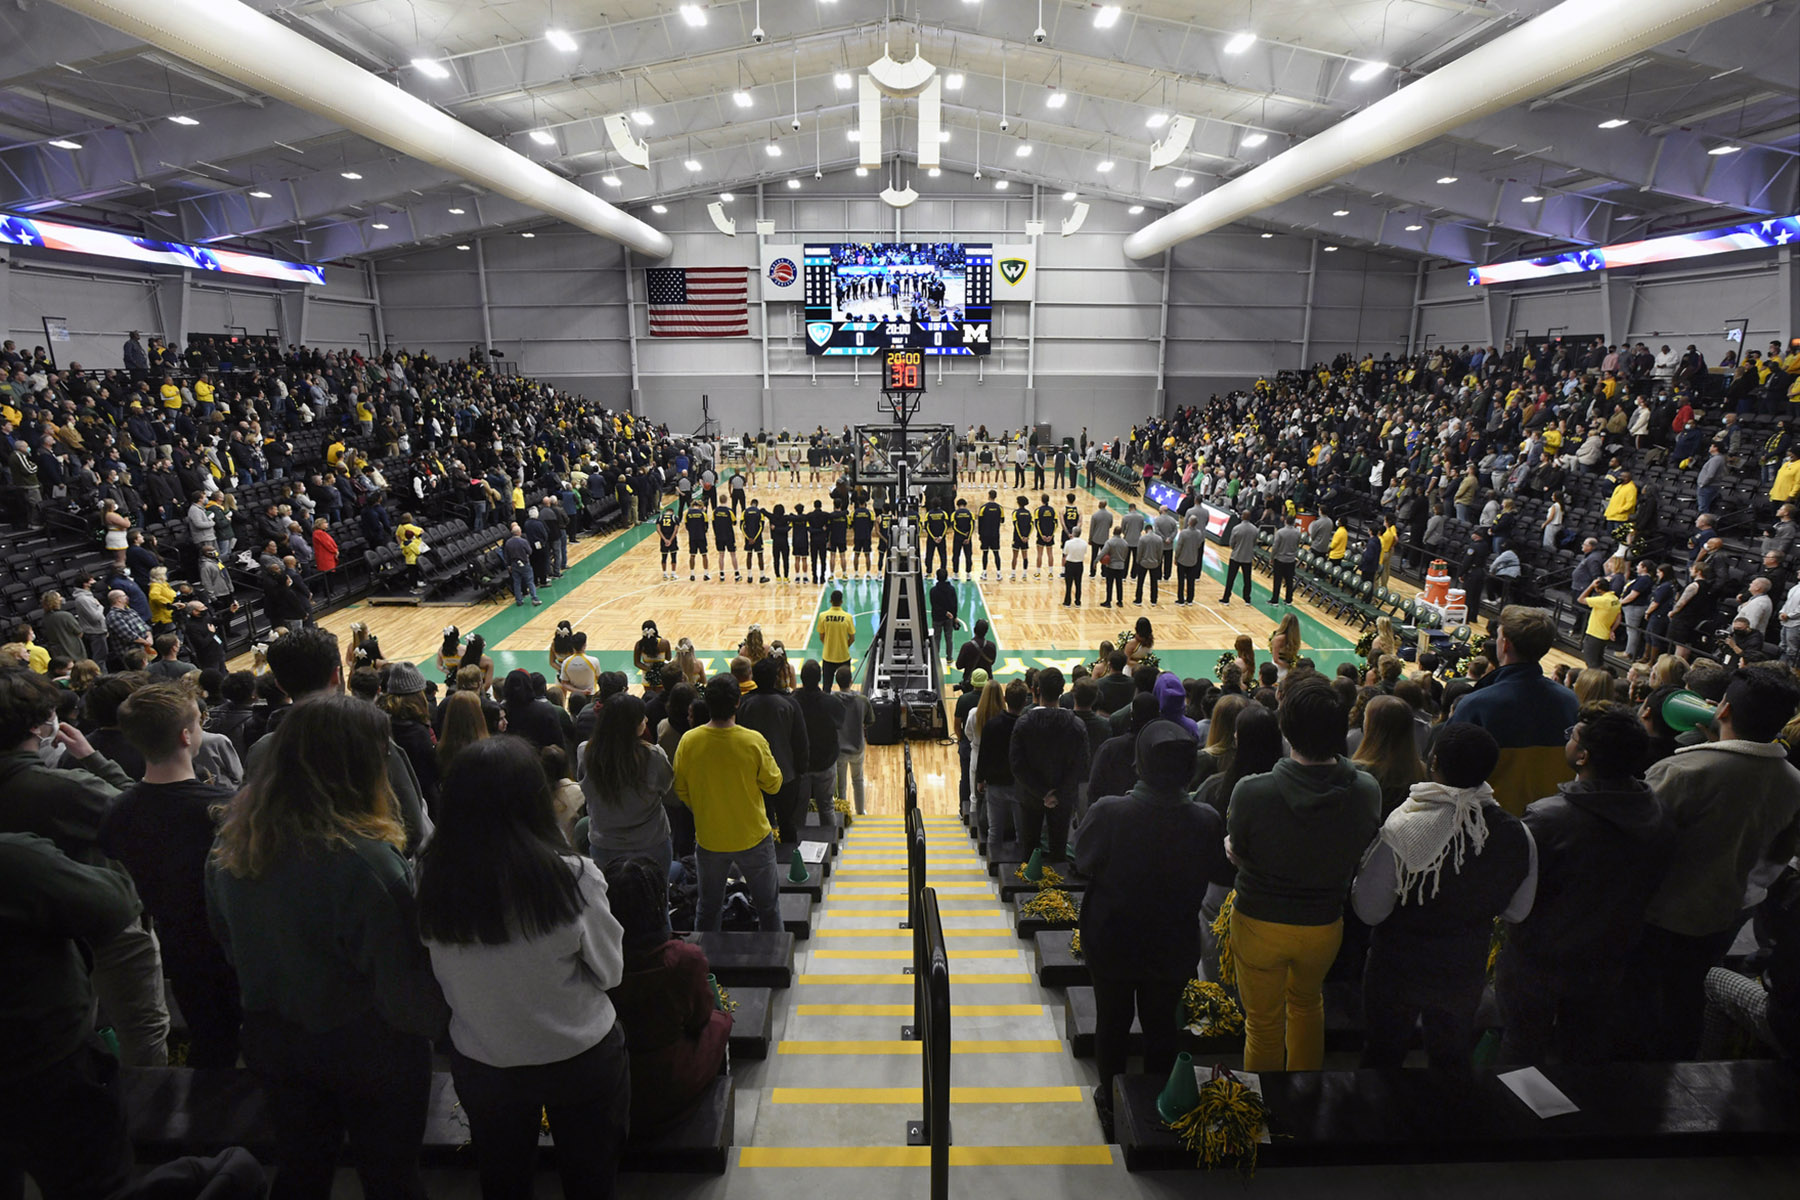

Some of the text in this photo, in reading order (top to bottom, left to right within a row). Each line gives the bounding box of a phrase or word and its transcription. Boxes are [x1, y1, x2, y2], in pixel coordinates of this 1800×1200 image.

[886, 323, 911, 335] 20:00
[962, 324, 989, 343] M
[856, 332, 864, 346] 0
[934, 332, 942, 346] 0
[887, 352, 921, 365] 20:00
[891, 365, 917, 388] 30
[662, 518, 671, 527] 12
[825, 615, 845, 623] STAFF
